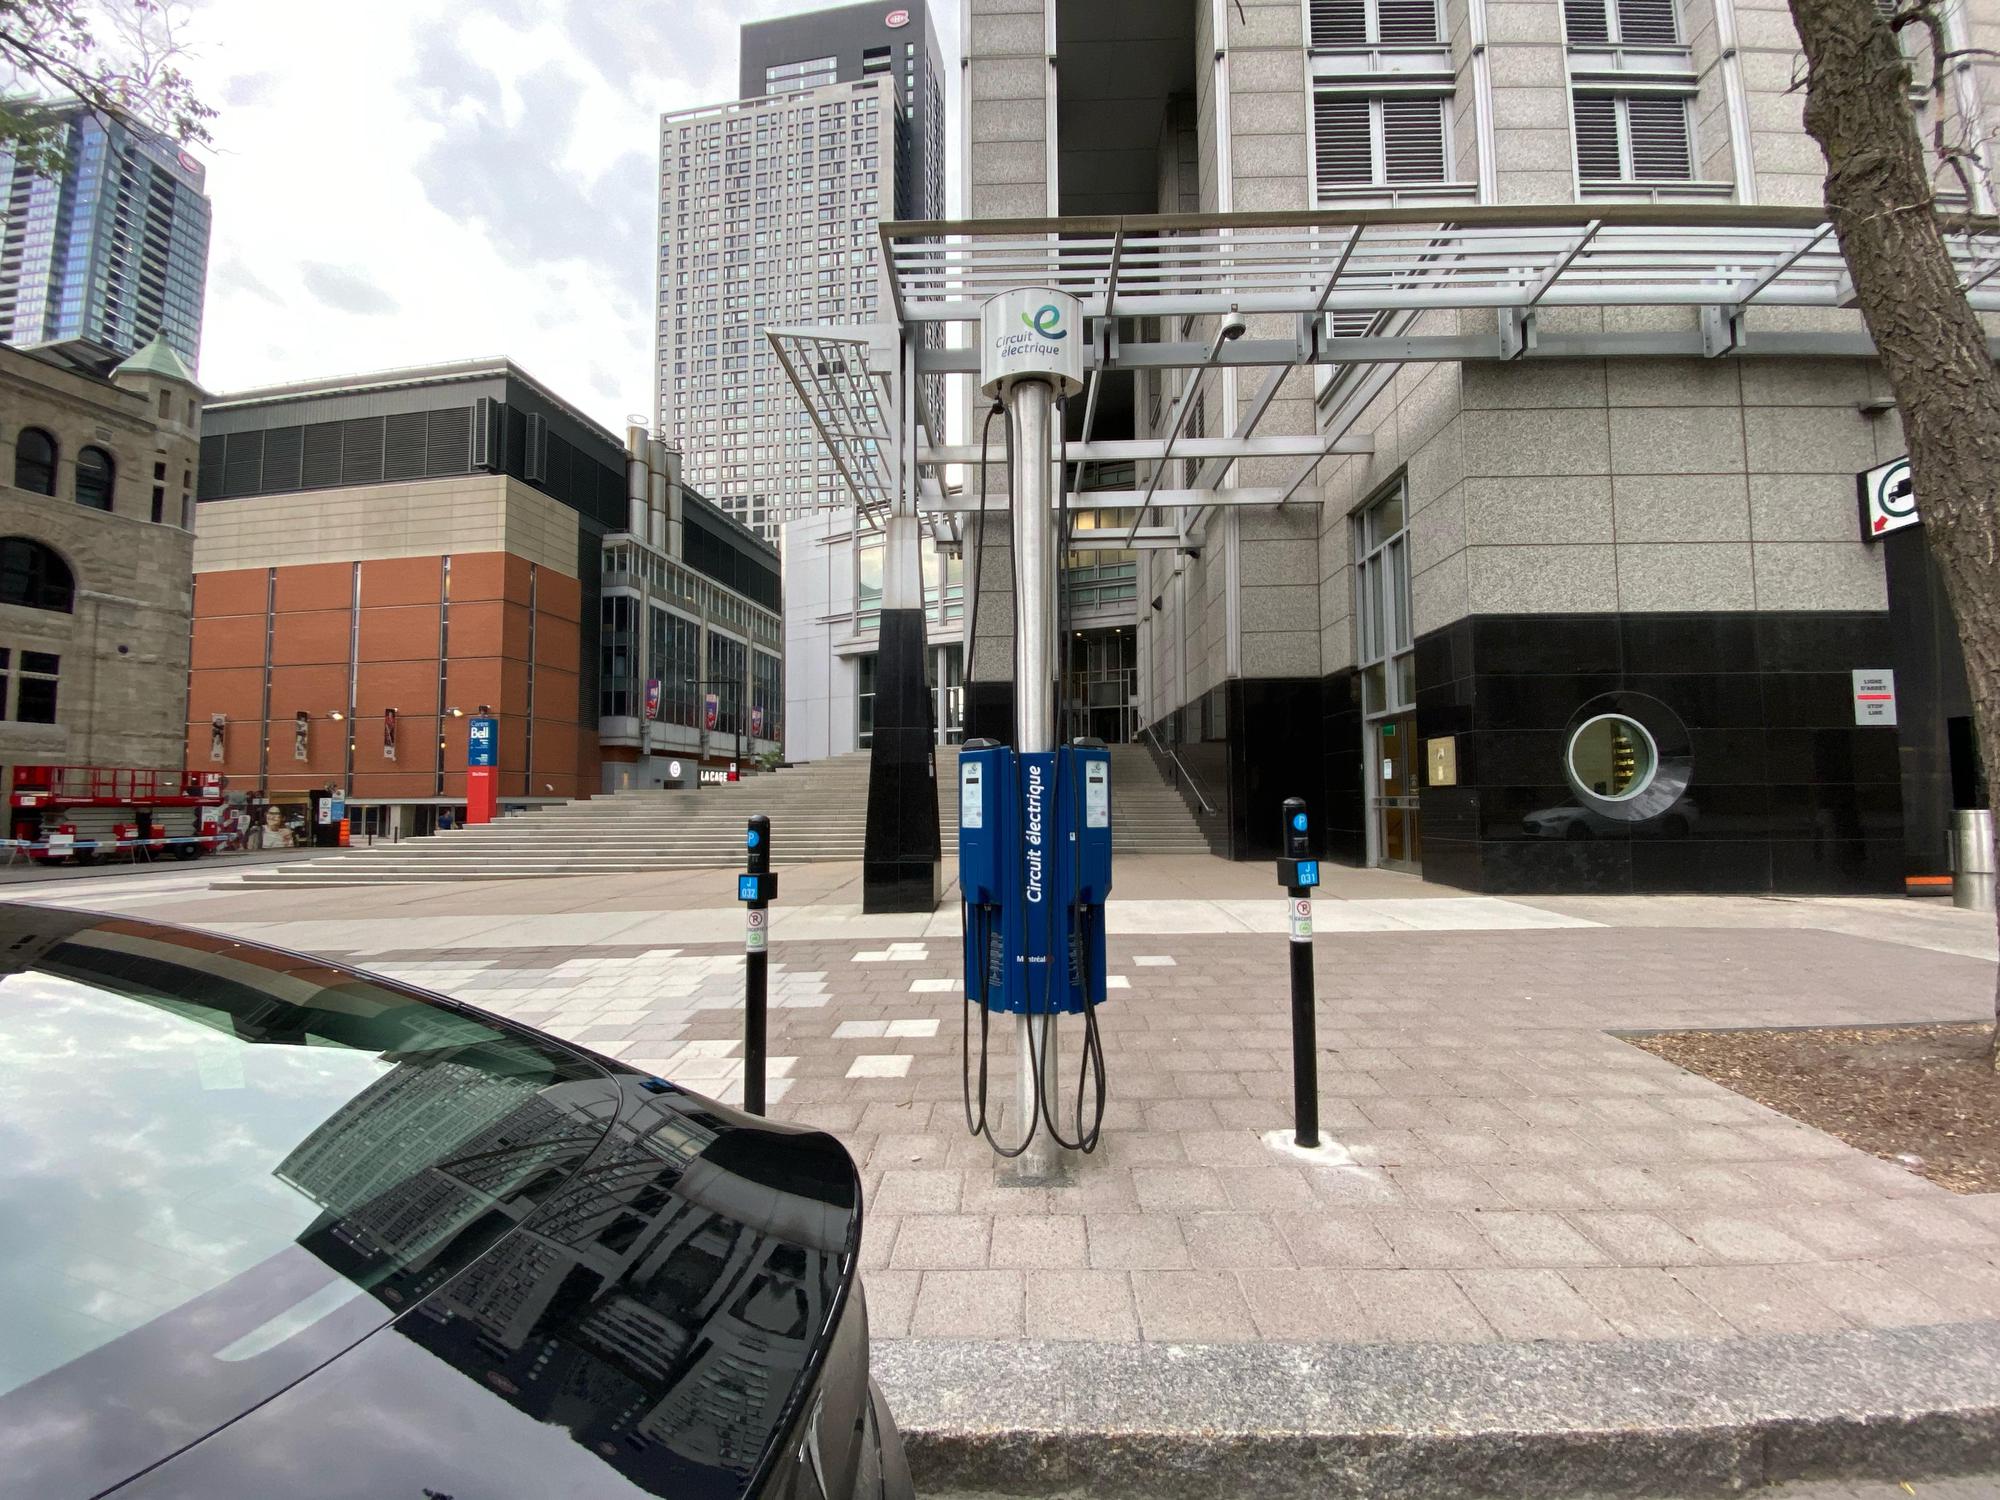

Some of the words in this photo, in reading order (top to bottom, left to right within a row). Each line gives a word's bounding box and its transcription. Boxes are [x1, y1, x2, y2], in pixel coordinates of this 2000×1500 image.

[995, 330, 1034, 348] Circuit
[470, 726, 489, 739] Bell
[700, 770, 710, 781] LA
[710, 771, 728, 782] CAGE
[1025, 765, 1045, 846] électrique
[1026, 848, 1042, 903] Circuit
[1016, 954, 1047, 963] Mntréal
